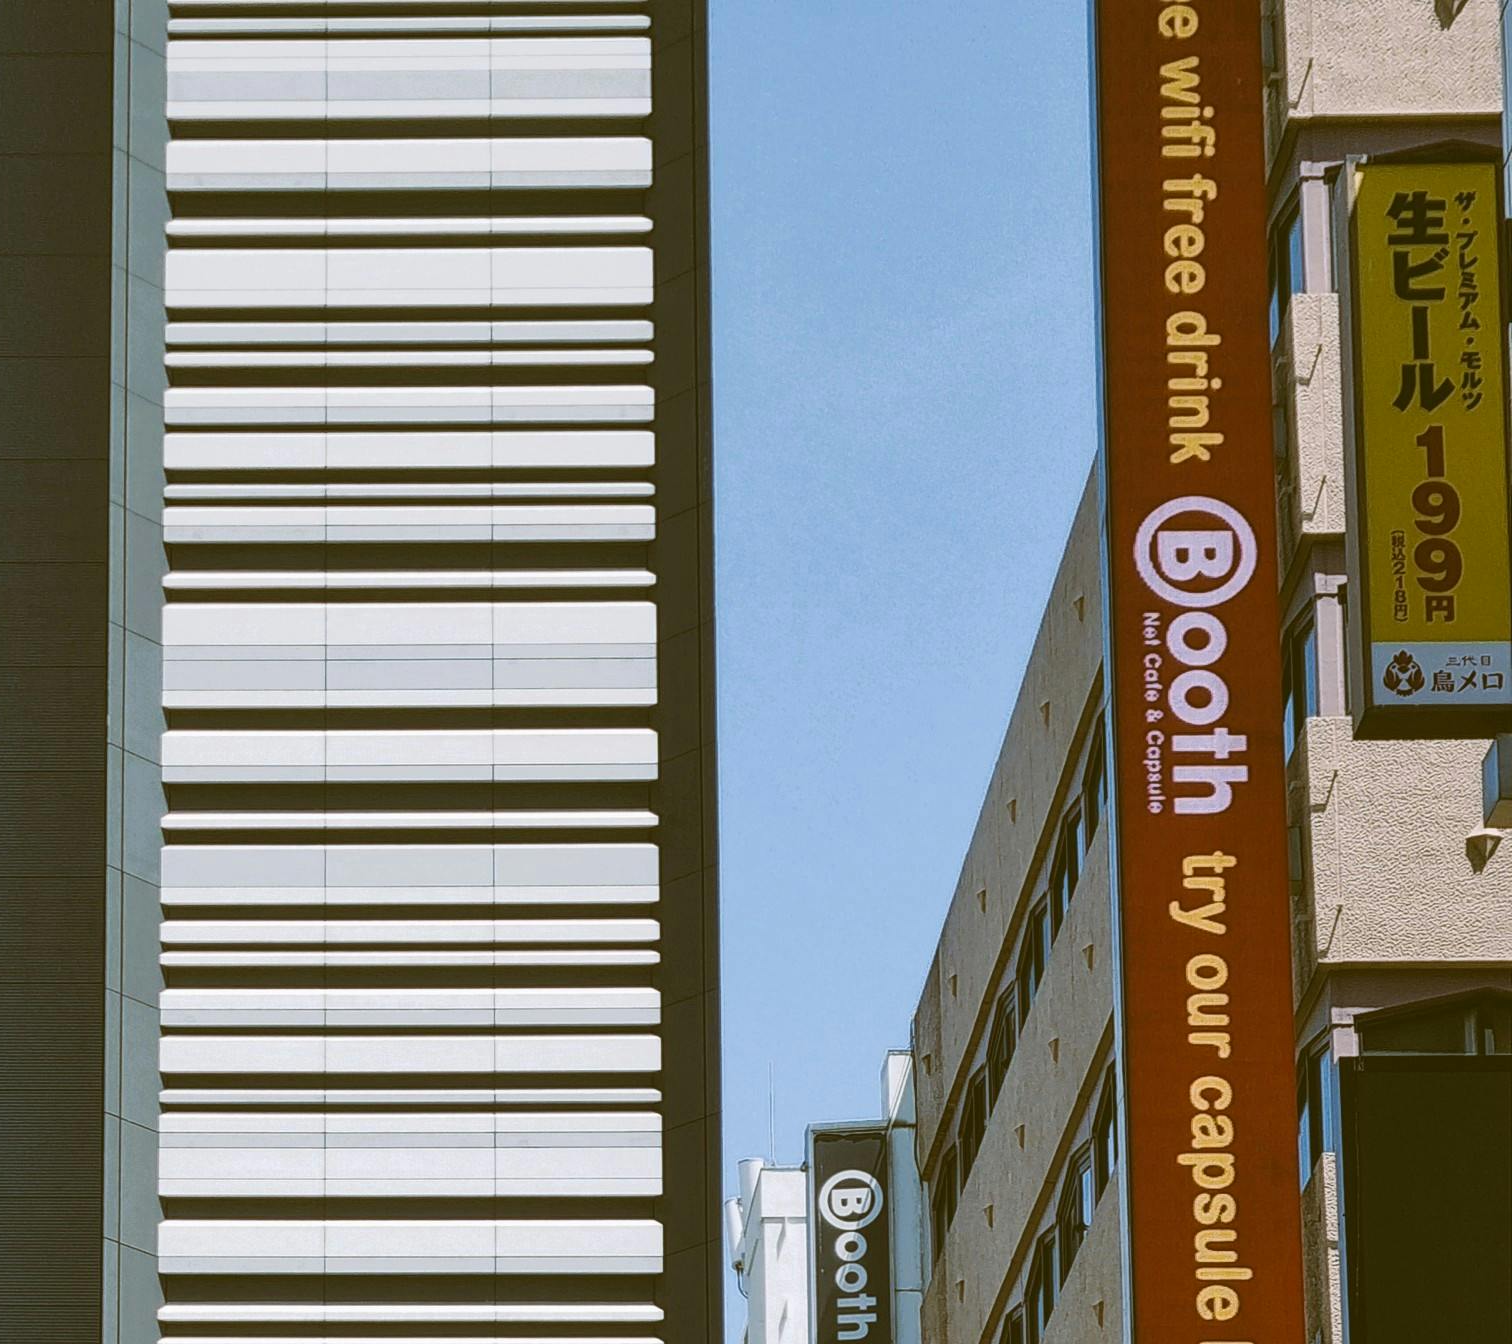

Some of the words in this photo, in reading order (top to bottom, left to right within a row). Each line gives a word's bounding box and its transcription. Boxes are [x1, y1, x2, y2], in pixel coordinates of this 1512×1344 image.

[1159, 57, 1217, 158] wifi
[1161, 174, 1218, 295] free
[1384, 191, 1456, 414] 生ビール
[1452, 190, 1486, 412] ザ・プレミアム・モルツ
[1165, 311, 1225, 465] drink
[1412, 425, 1465, 624] 199円
[1133, 496, 1259, 816] Booth
[1142, 611, 1162, 646] Net
[1143, 653, 1164, 702] Cafe
[1444, 654, 1493, 668] 三代目
[1145, 708, 1163, 723] &
[1430, 669, 1504, 696] 鳥メロ
[1141, 731, 1167, 814] Capsule
[1169, 849, 1237, 937] try
[1184, 954, 1232, 1060] our
[1176, 1075, 1254, 1323] capsule
[818, 1168, 884, 1342] Booth
